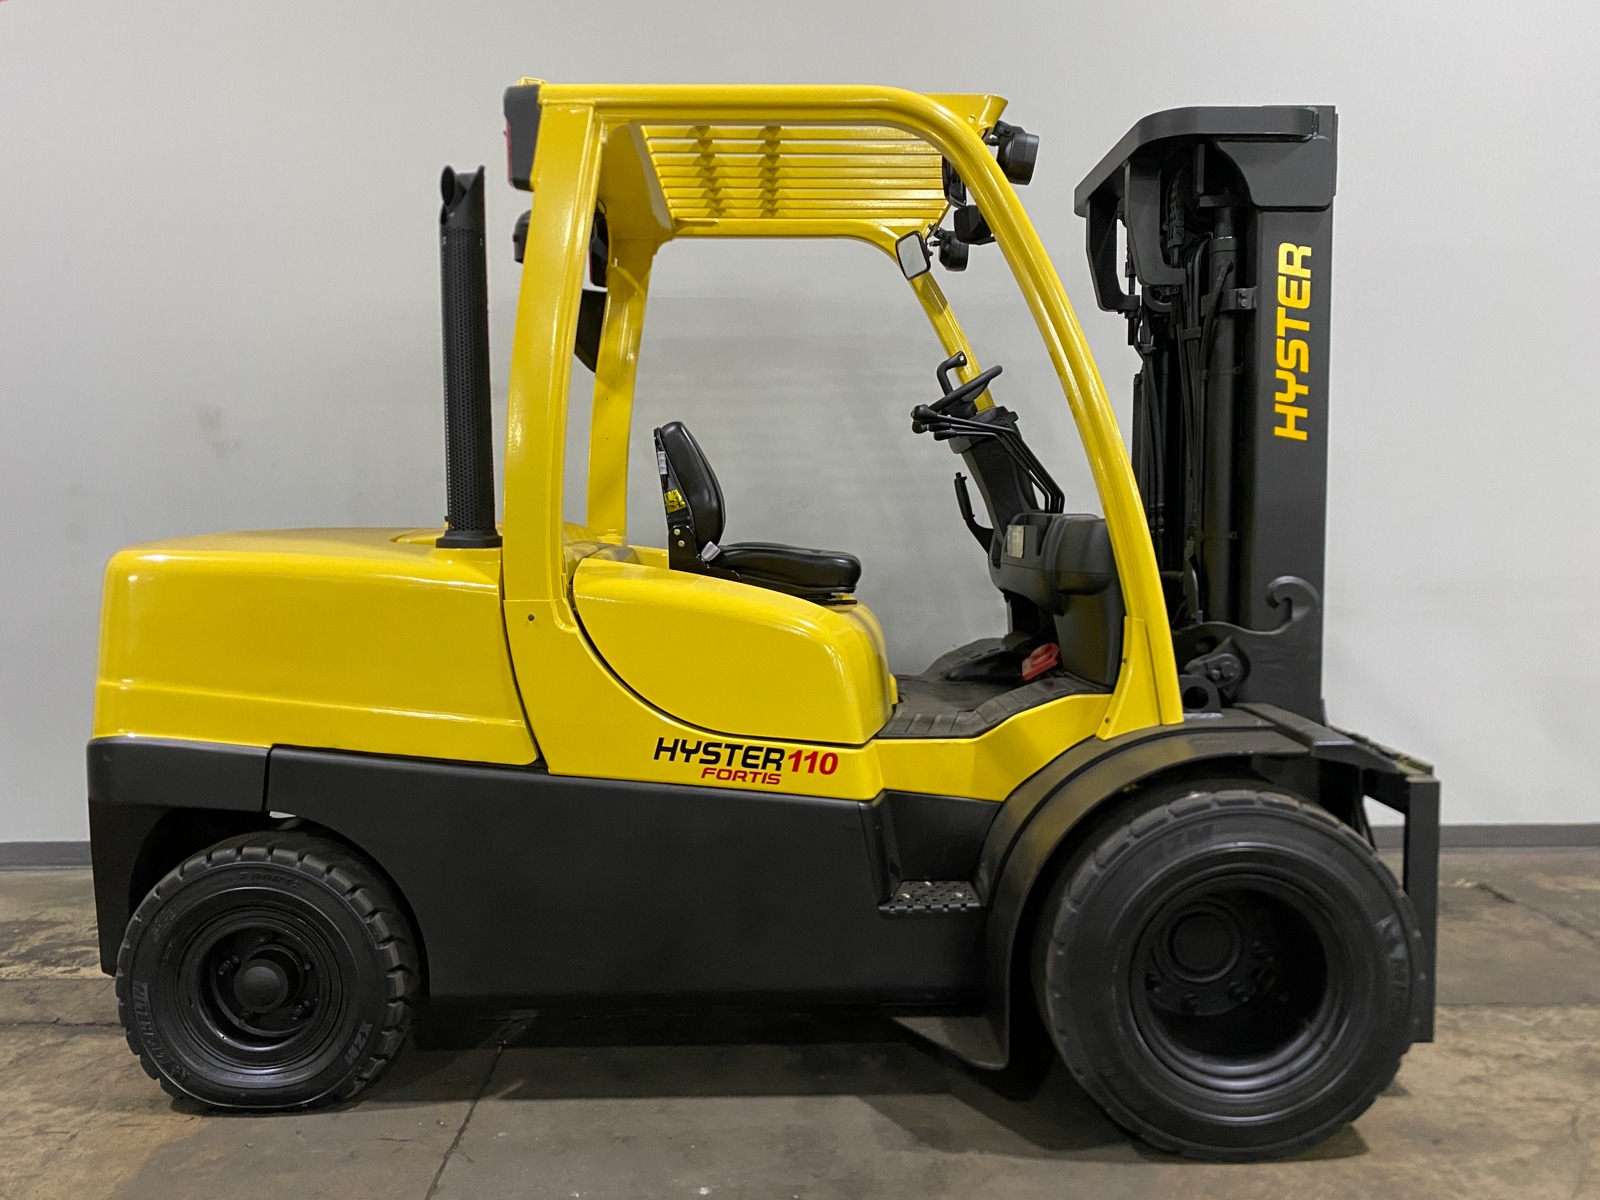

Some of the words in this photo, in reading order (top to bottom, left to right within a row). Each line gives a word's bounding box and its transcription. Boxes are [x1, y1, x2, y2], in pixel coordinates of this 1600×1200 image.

[1274, 242, 1312, 441] HYSTER
[653, 737, 786, 772] HYSTER
[788, 749, 839, 775] 110
[701, 767, 782, 785] FORTIS
